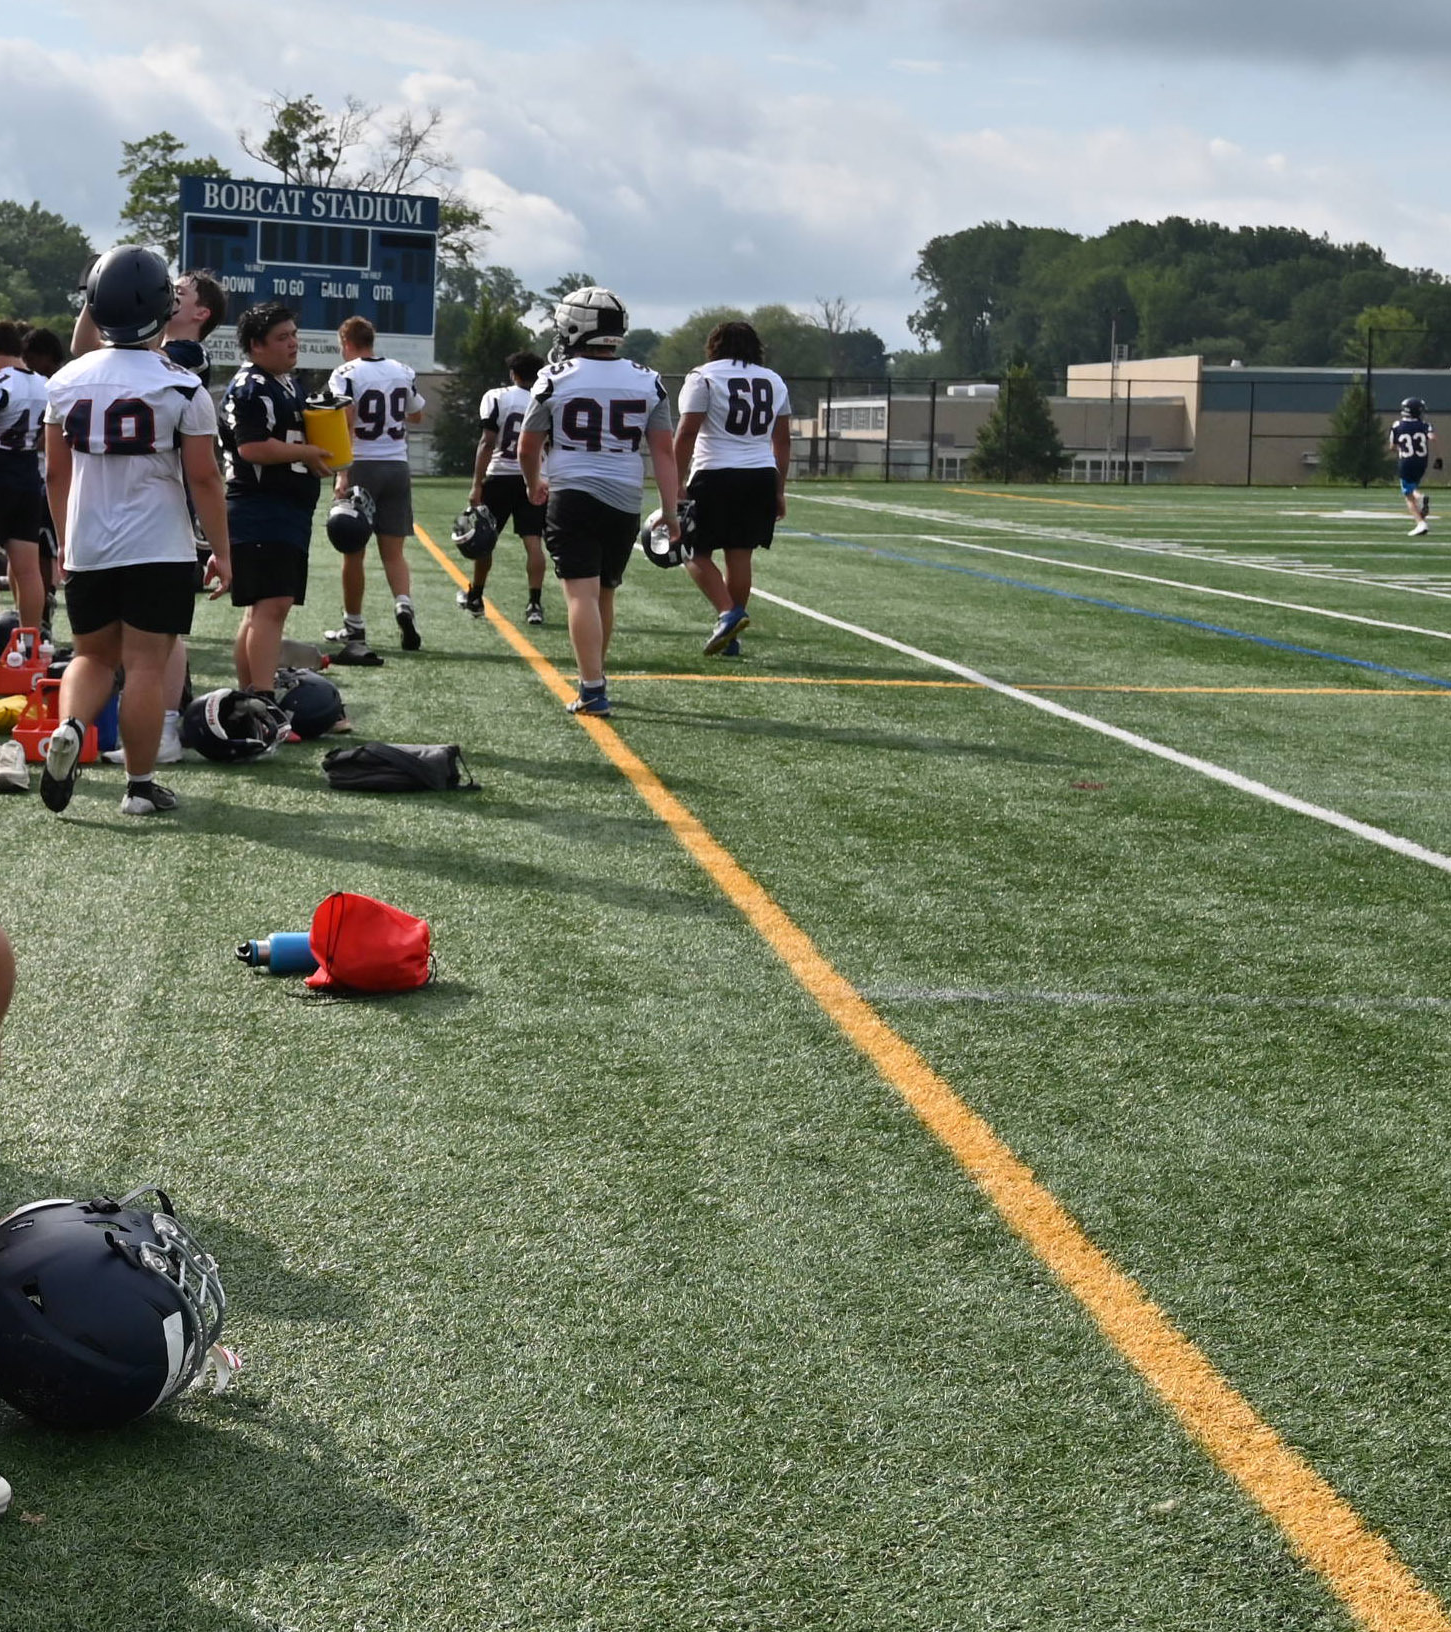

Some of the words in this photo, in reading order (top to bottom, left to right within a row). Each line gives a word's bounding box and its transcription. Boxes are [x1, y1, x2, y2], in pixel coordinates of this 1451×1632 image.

[203, 182, 305, 216] BOBCAT
[311, 191, 423, 225] STADIUM
[222, 276, 255, 293] DOWN
[273, 278, 287, 296] TO
[289, 279, 305, 296] GO
[345, 283, 359, 299] ON
[373, 285, 393, 301] QTR
[354, 387, 408, 441] 99
[725, 378, 773, 436] 68
[562, 398, 646, 452] 95
[1398, 432, 1428, 458] 33
